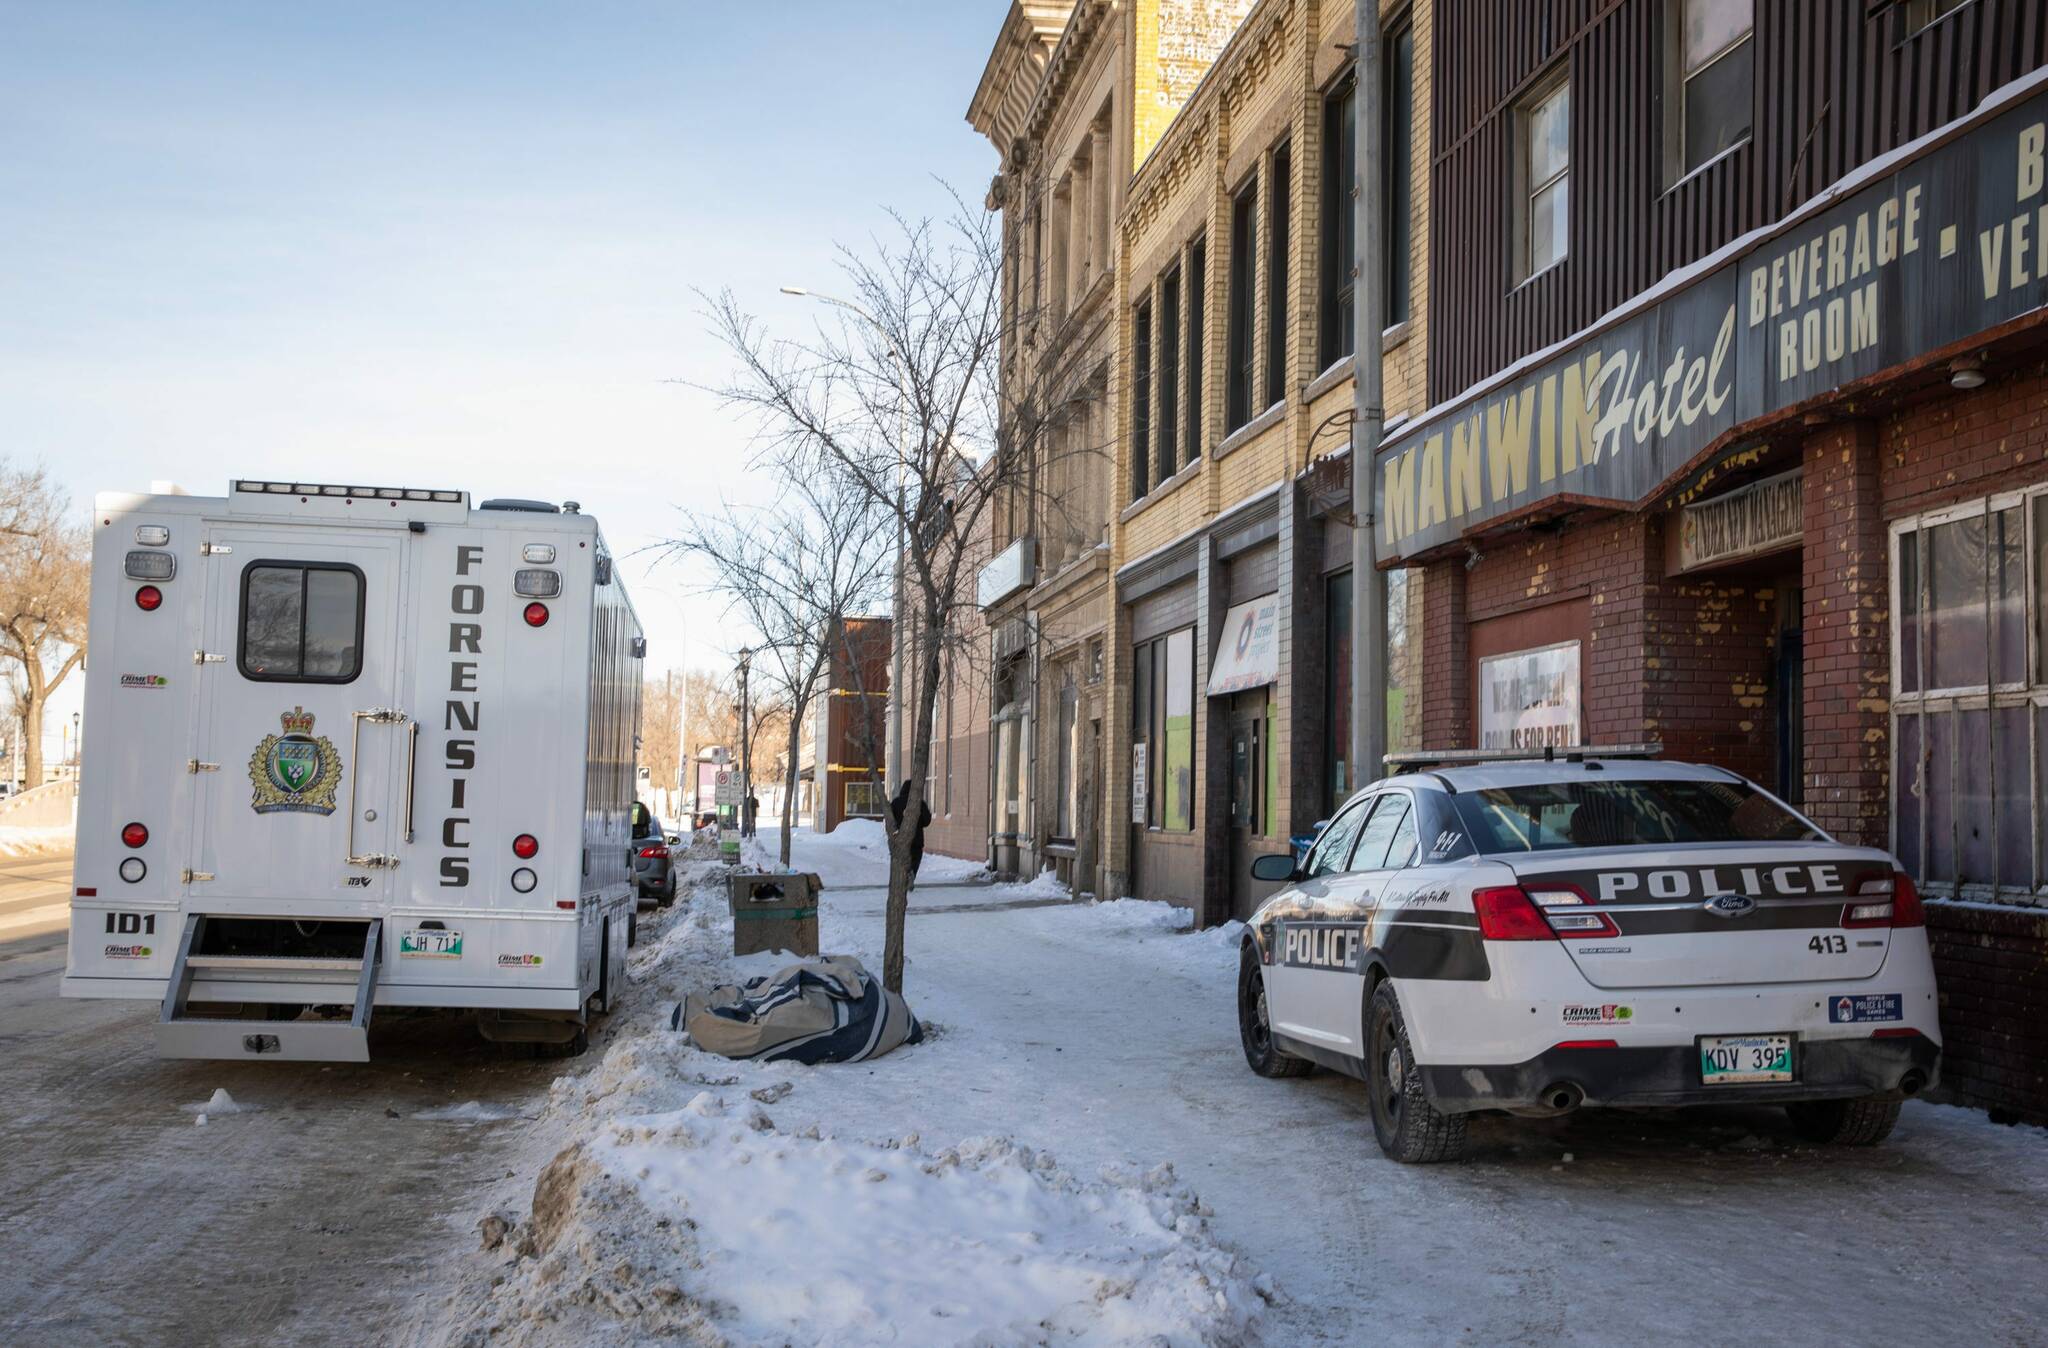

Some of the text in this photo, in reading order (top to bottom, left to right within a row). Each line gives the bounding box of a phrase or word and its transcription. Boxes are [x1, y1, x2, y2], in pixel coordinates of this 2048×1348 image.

[1750, 184, 1922, 328] BEVERAGE
[1780, 281, 1879, 383] ROOM
[1384, 303, 1737, 546] MANWIN Hotel
[439, 545, 485, 888] FORENSICS
[1597, 864, 1845, 901] POLICE
[1721, 897, 1745, 909] Ford
[105, 912, 156, 935] ID1
[403, 936, 428, 951] CJH
[1285, 928, 1360, 969] POLICE
[1808, 935, 1848, 954] 413
[1562, 1007, 1602, 1016] CRIME
[1855, 1000, 1876, 1010] POLICE
[1882, 999, 1896, 1009] FIRE
[1705, 1046, 1786, 1072] KDV 395
